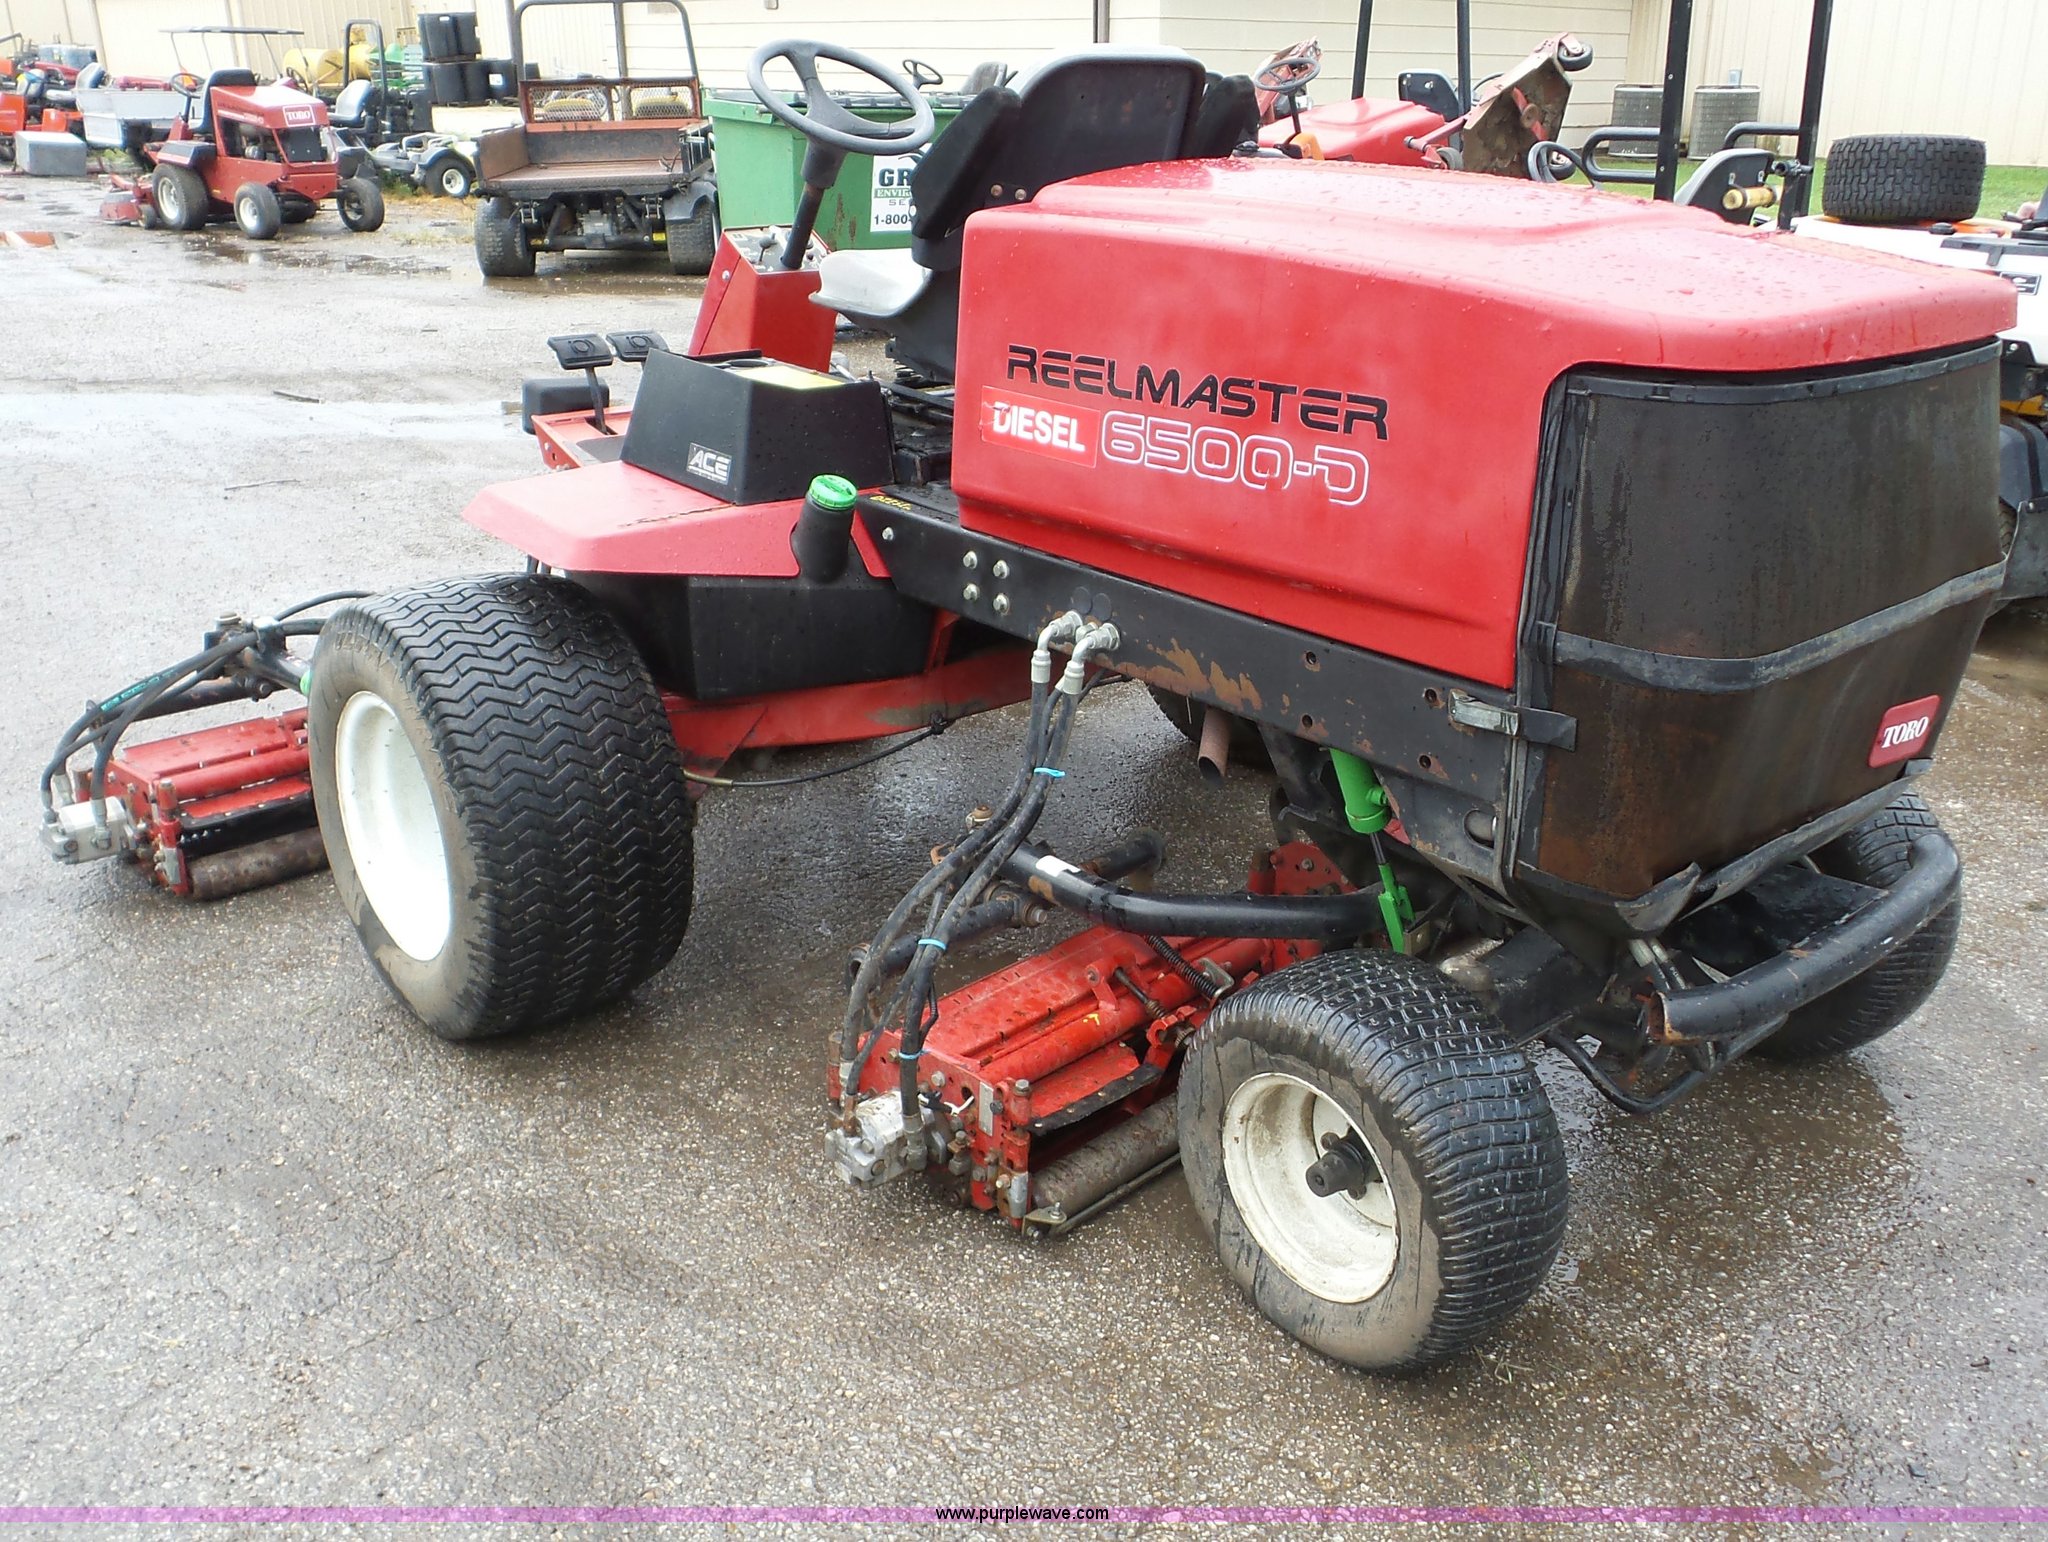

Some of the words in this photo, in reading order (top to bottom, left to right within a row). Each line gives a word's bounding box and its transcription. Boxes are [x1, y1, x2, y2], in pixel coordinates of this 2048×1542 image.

[286, 110, 311, 121] TORO
[1006, 344, 1388, 441] REELMASTER
[992, 400, 1086, 453] DIESEL
[690, 450, 731, 478] ACE
[1102, 410, 1370, 506] 6500-D
[1881, 716, 1929, 749] TORO
